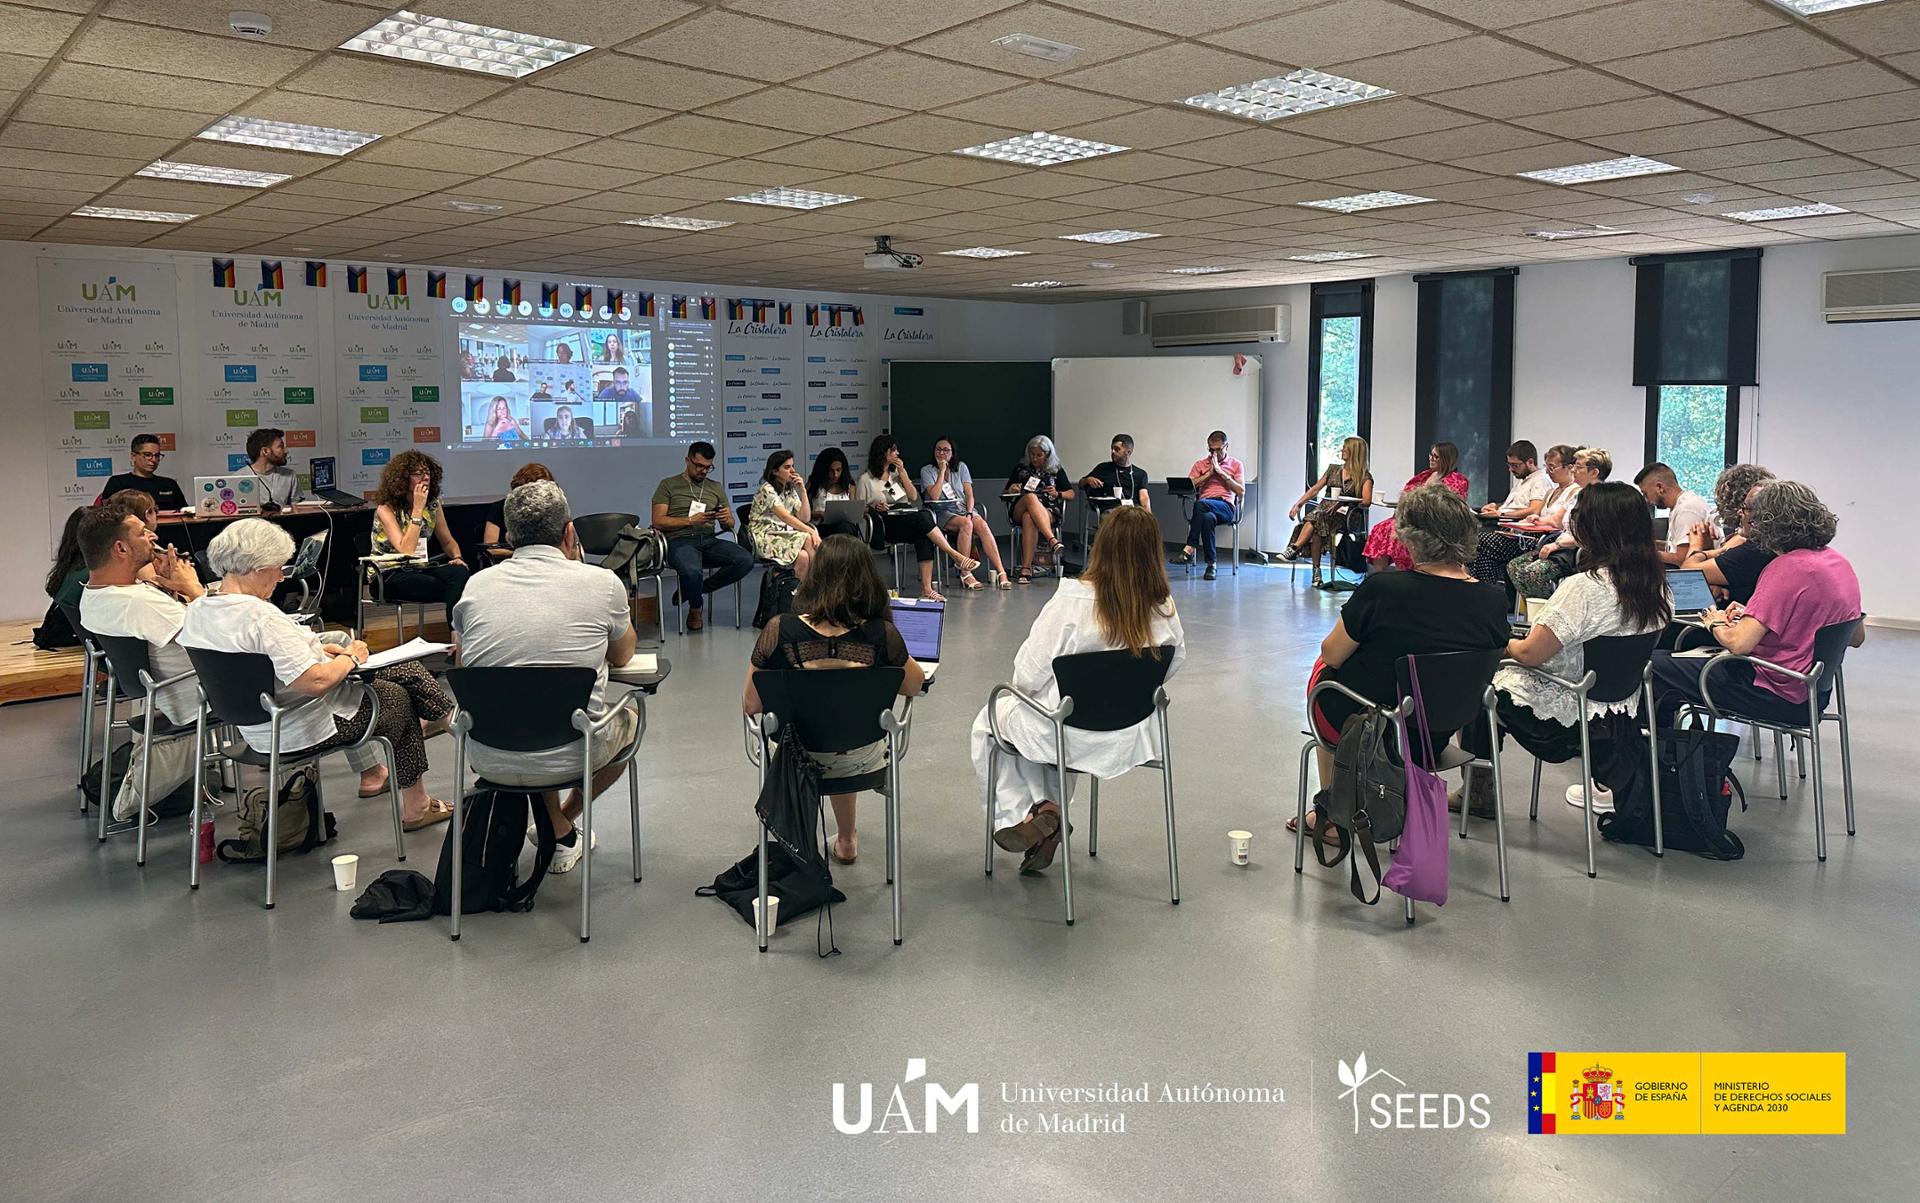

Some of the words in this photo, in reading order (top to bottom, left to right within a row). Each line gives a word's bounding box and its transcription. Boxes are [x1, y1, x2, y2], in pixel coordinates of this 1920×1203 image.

[57, 305, 112, 315] Universidad
[116, 306, 161, 316] Autónoma
[211, 310, 261, 320] Universidad
[263, 311, 304, 321] Autónoma
[87, 316, 99, 324] de
[101, 316, 134, 325] Madrid
[348, 313, 392, 323] Universidad
[238, 320, 249, 328] de
[251, 320, 280, 329] Madrid
[371, 323, 381, 331] de
[382, 323, 408, 332] Madrid
[727, 321, 742, 335] La
[744, 321, 787, 335] Cristalera
[810, 325, 822, 337] La
[825, 326, 864, 338] Cristalera
[883, 328, 896, 341] La
